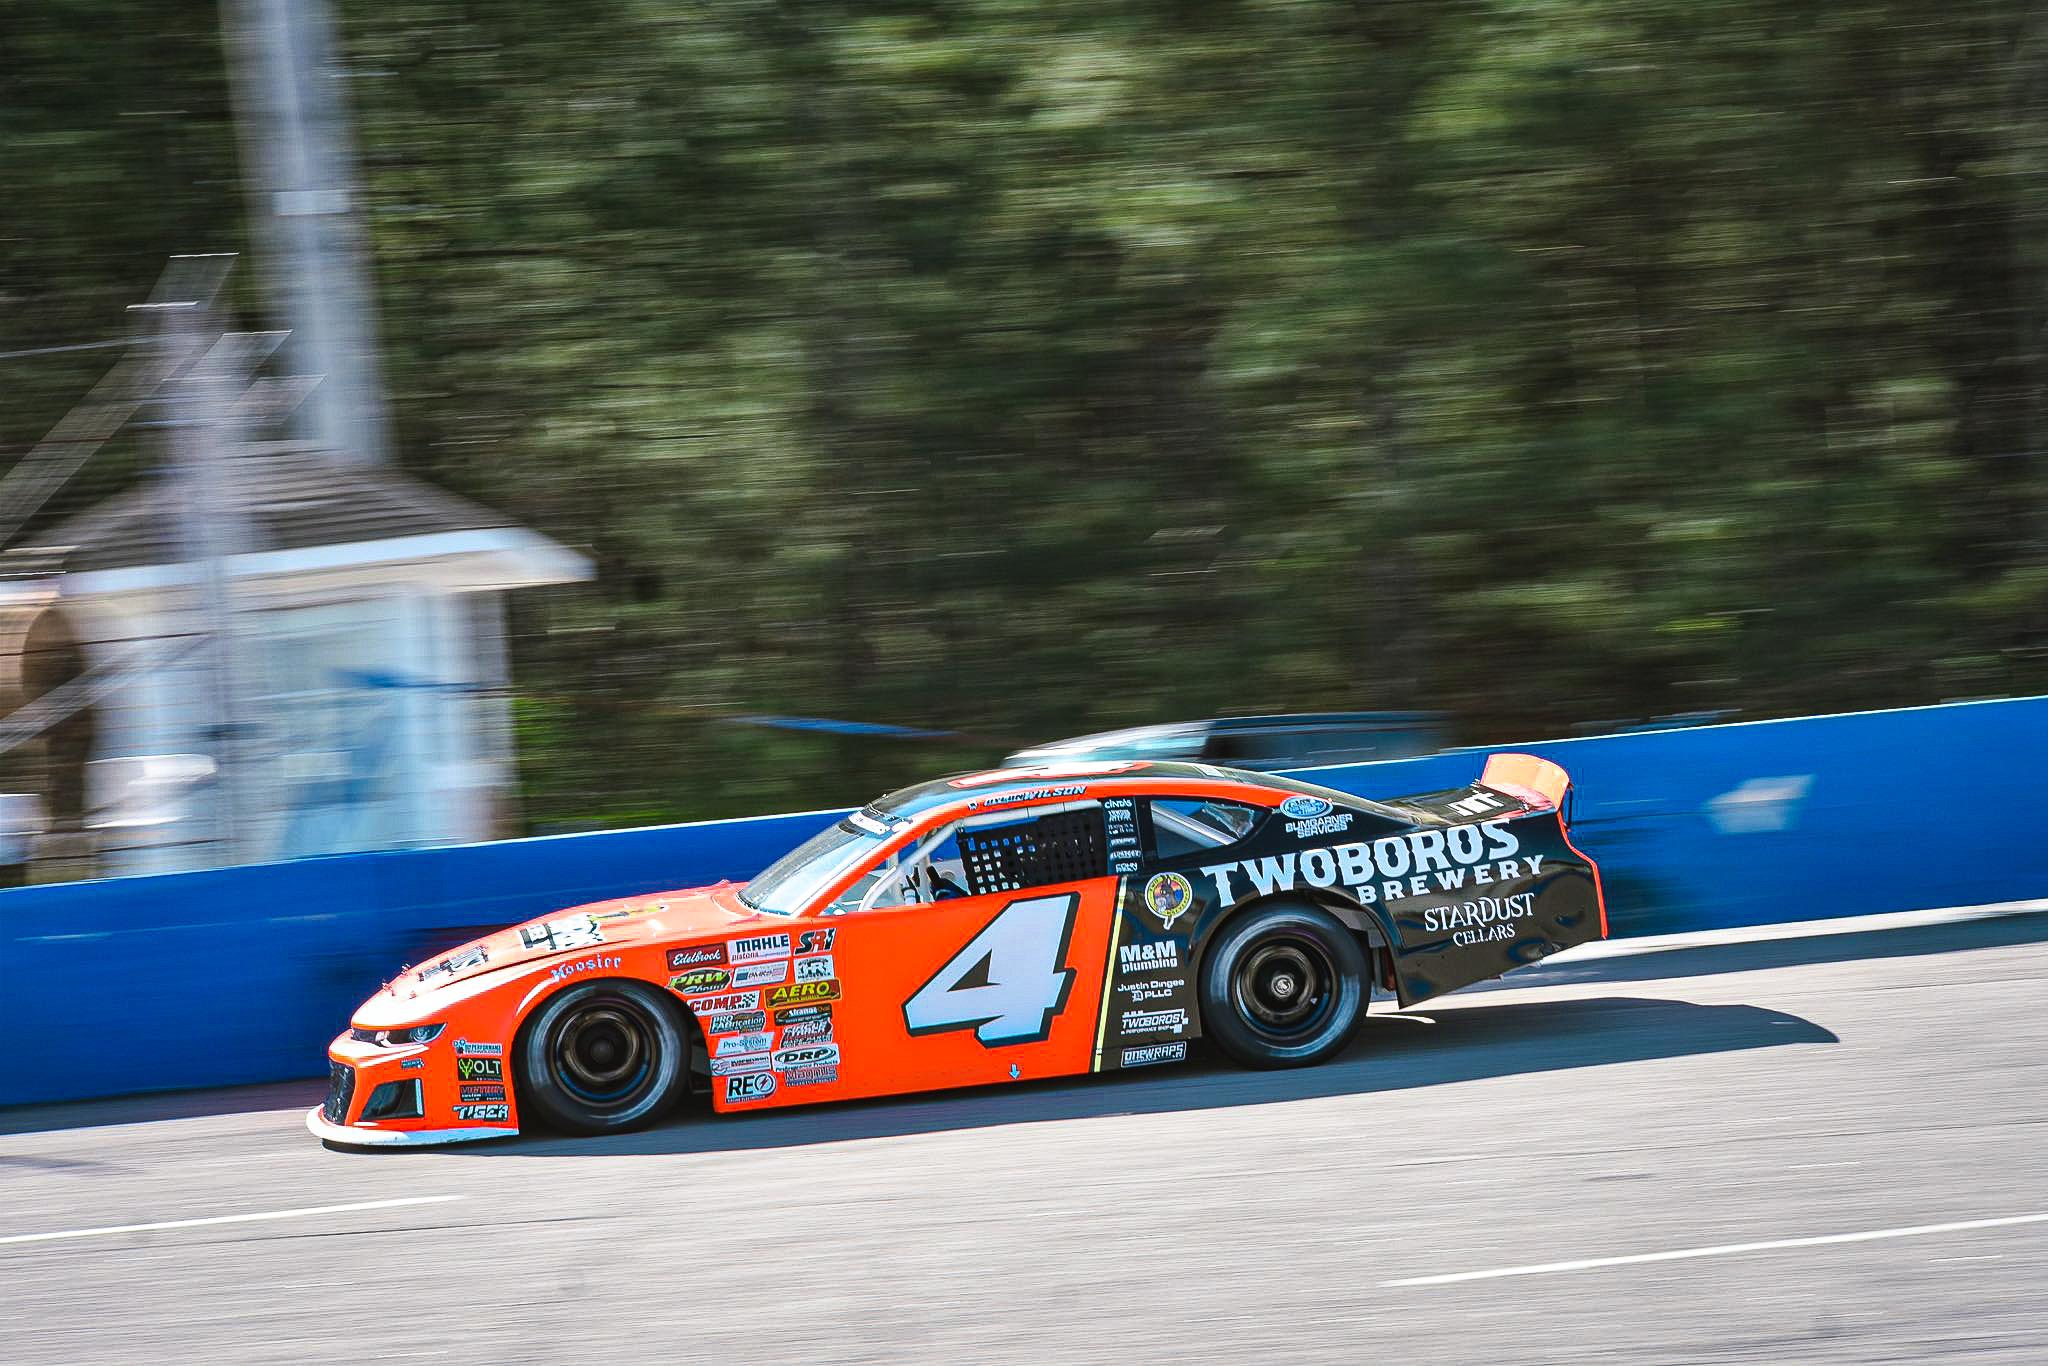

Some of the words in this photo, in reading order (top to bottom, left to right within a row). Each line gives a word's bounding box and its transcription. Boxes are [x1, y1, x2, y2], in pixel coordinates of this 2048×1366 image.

[1024, 786, 1088, 800] WILSON
[1285, 813, 1354, 833] BUMGARNER
[1297, 821, 1348, 839] SERVICES
[1200, 818, 1520, 908] TWOBOROS
[1356, 855, 1545, 905] BREWERY
[1424, 892, 1536, 932] STARDUST
[1453, 923, 1515, 947] CELLARS
[736, 935, 789, 953] MAHLE
[1120, 940, 1177, 963] M&M
[673, 949, 721, 966] Edelbrock
[1122, 957, 1178, 974] plumbing
[550, 954, 622, 983] Hoosier
[902, 891, 1081, 1049] 4
[668, 972, 728, 988] PRW
[1117, 982, 1149, 992] Justin
[772, 982, 830, 999] AERO
[1144, 989, 1172, 999] PLLC
[690, 995, 742, 1012] COMP
[1122, 1013, 1181, 1029] TWOBOROS
[784, 1049, 829, 1062] DRP
[458, 1058, 501, 1080] VOLT
[452, 1105, 508, 1120] TIGER
